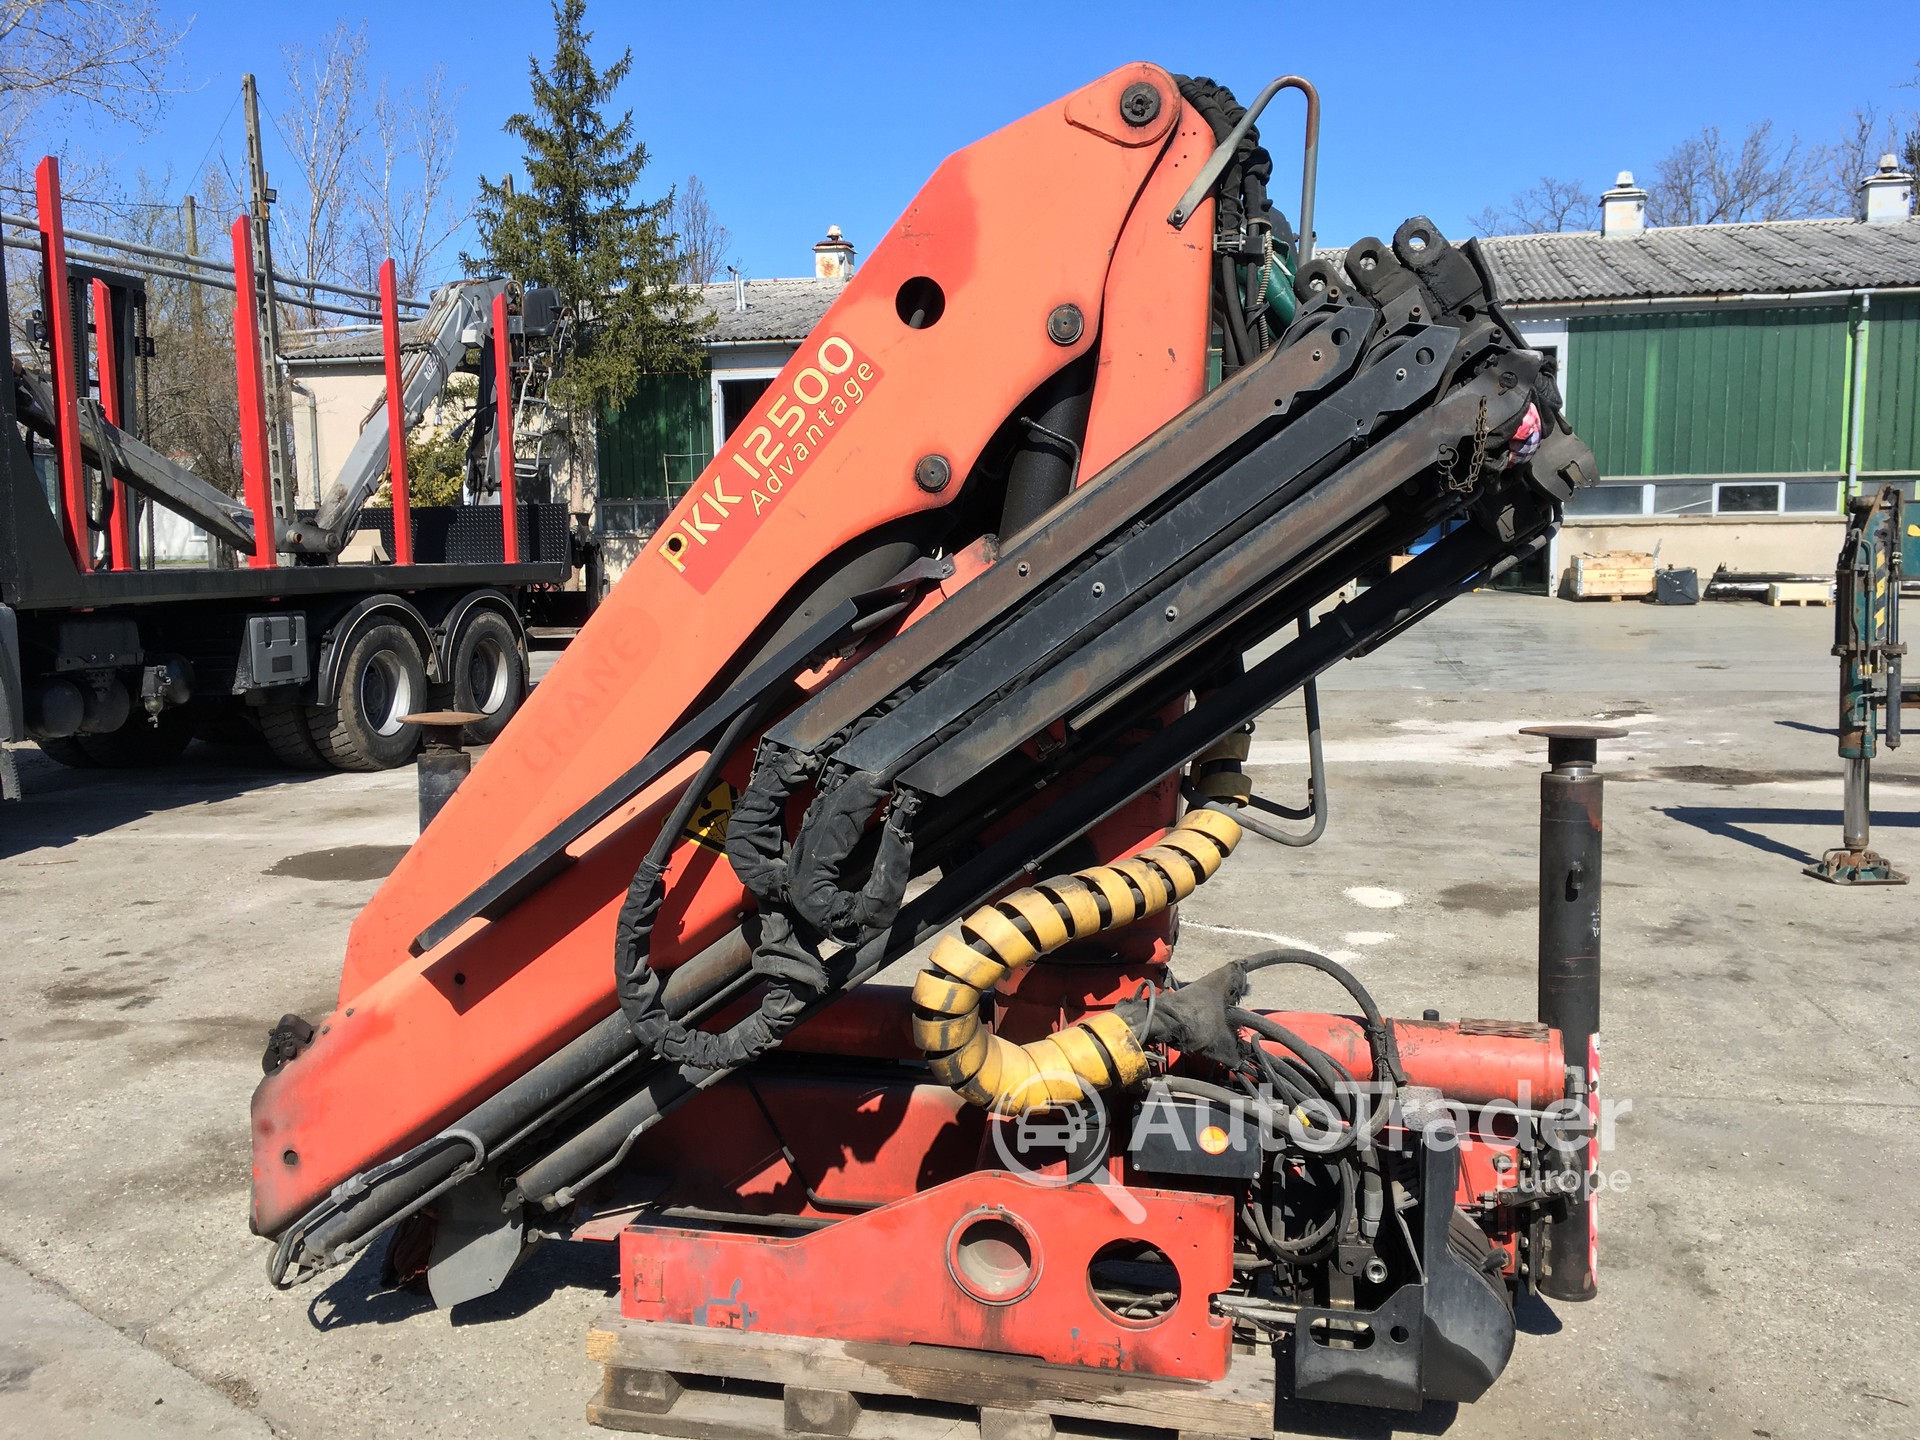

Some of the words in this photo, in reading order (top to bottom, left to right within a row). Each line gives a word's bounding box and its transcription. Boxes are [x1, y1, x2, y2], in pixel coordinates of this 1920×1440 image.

[657, 473, 744, 573] PKK
[731, 336, 855, 480] 12500
[750, 361, 874, 516] Advantage
